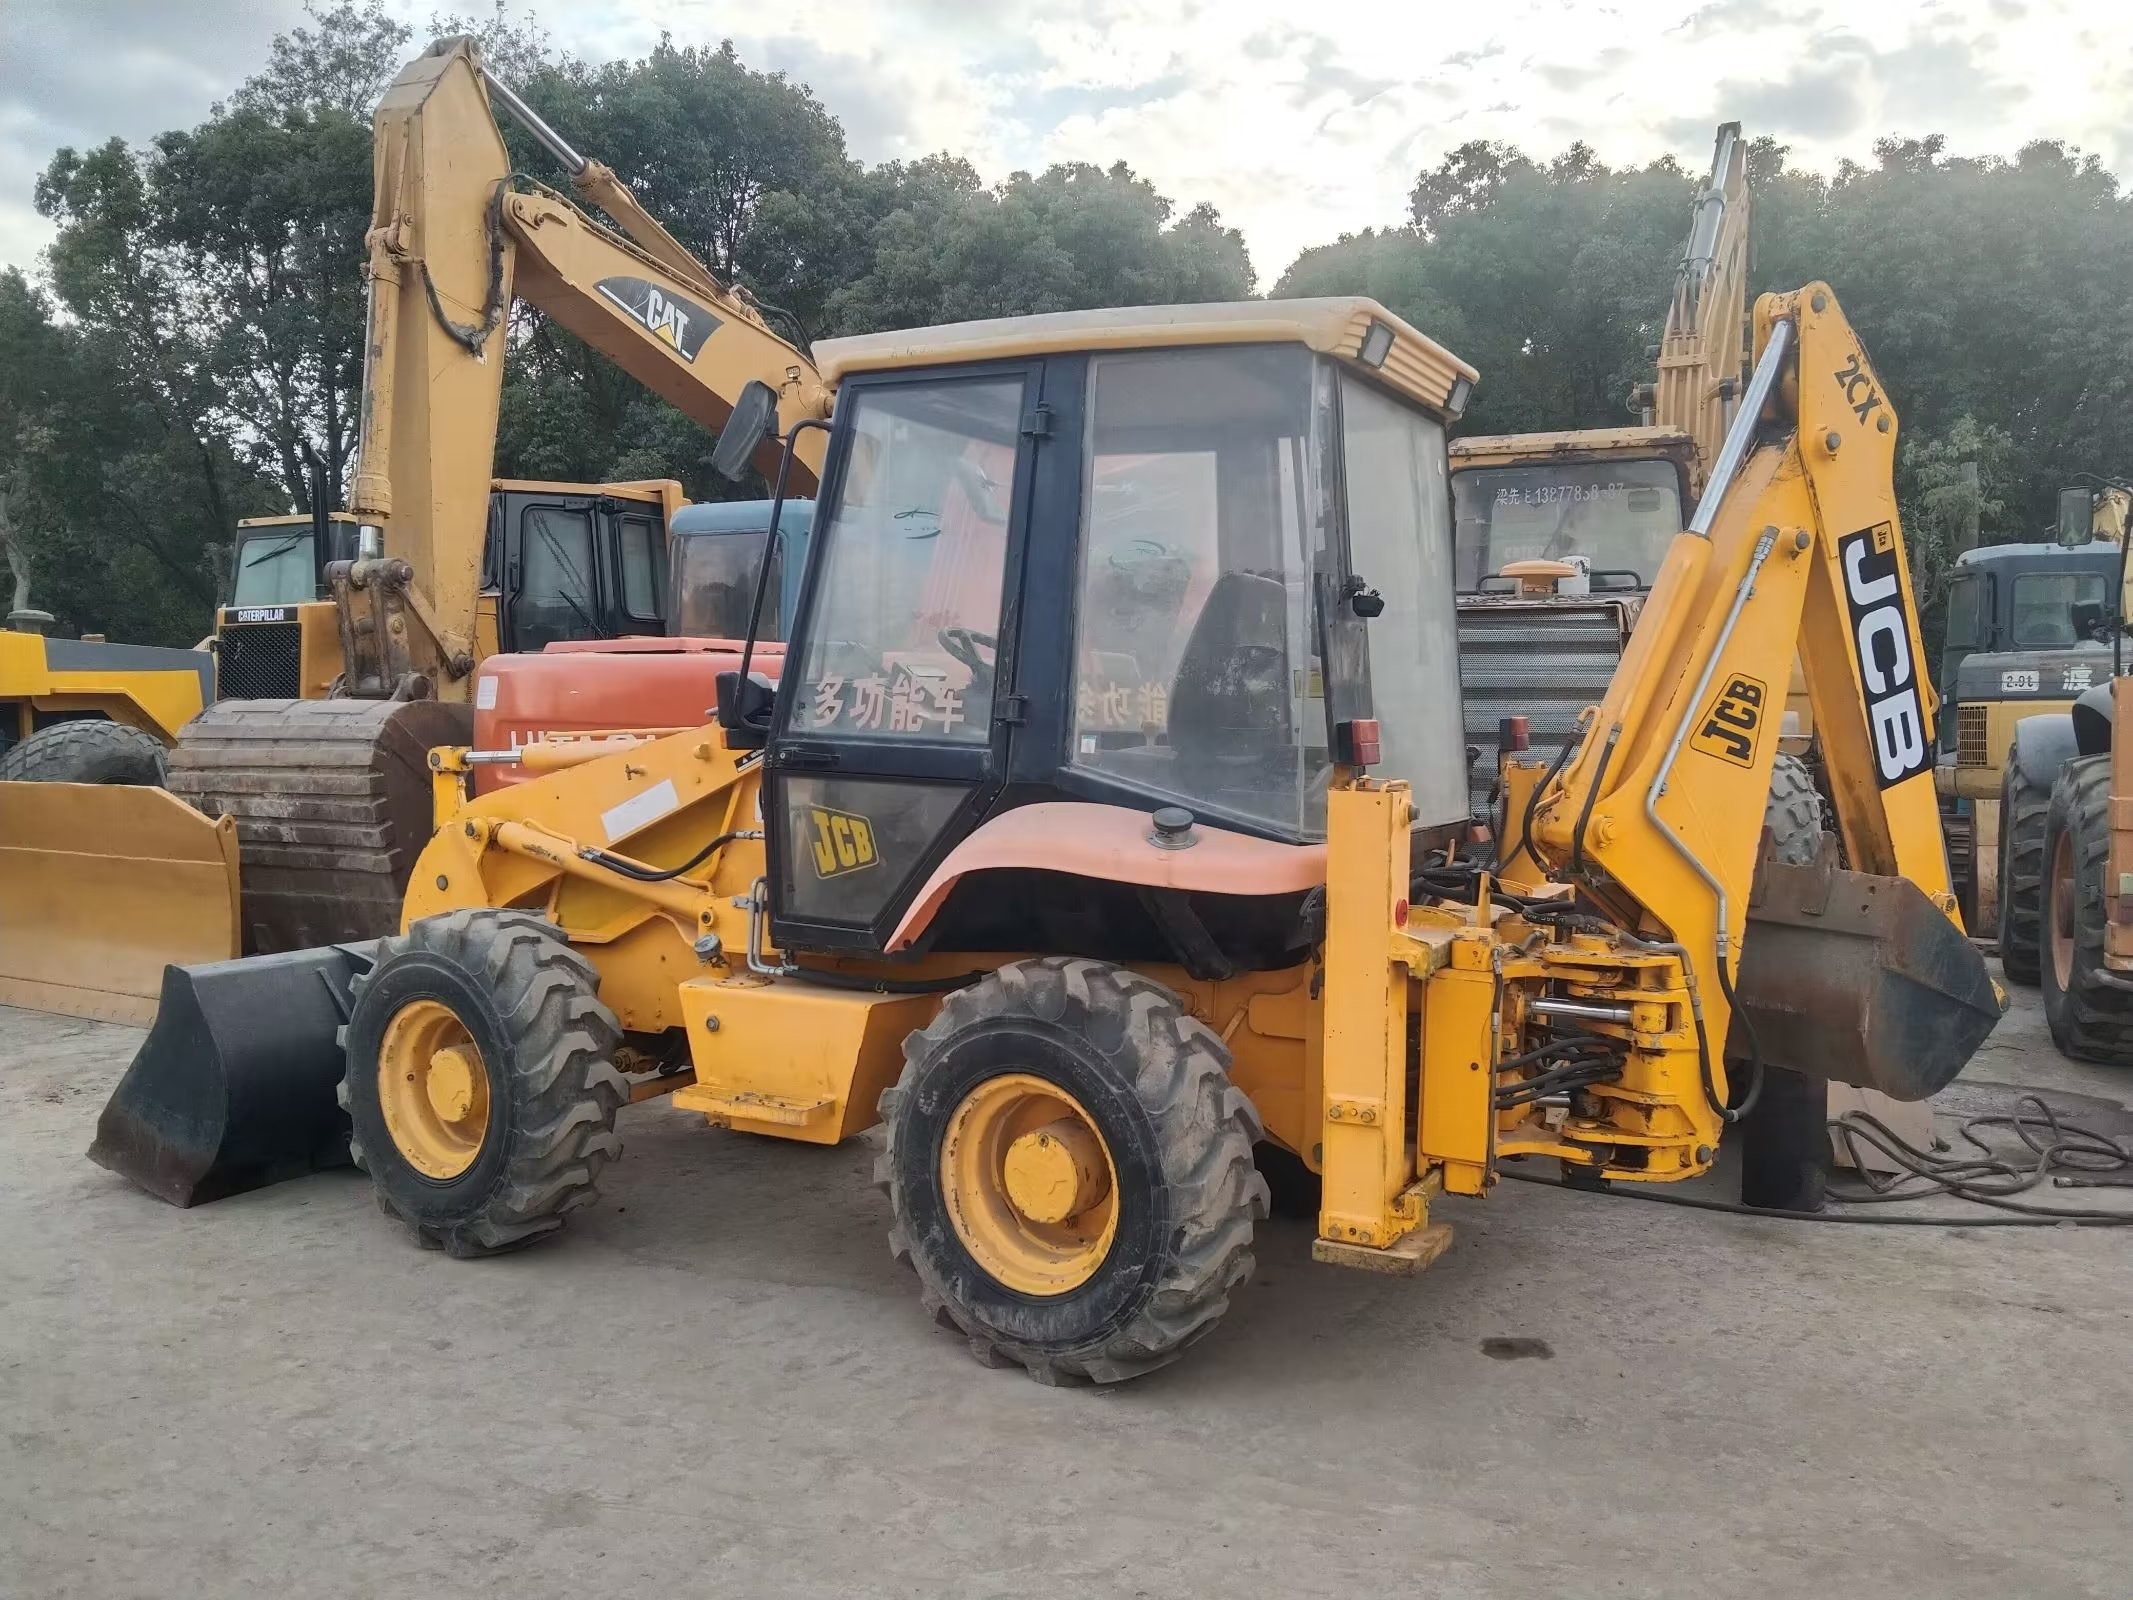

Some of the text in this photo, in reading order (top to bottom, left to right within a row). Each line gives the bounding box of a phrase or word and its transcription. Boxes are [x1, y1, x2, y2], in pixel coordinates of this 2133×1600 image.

[646, 289, 690, 351] CAT
[1834, 353, 1883, 427] 2CX
[237, 608, 285, 622] CATERPILLAR
[1845, 537, 1925, 781] JCB
[813, 671, 965, 734] 多功能车
[1700, 679, 1762, 761] JCB
[811, 810, 873, 874] JCB
